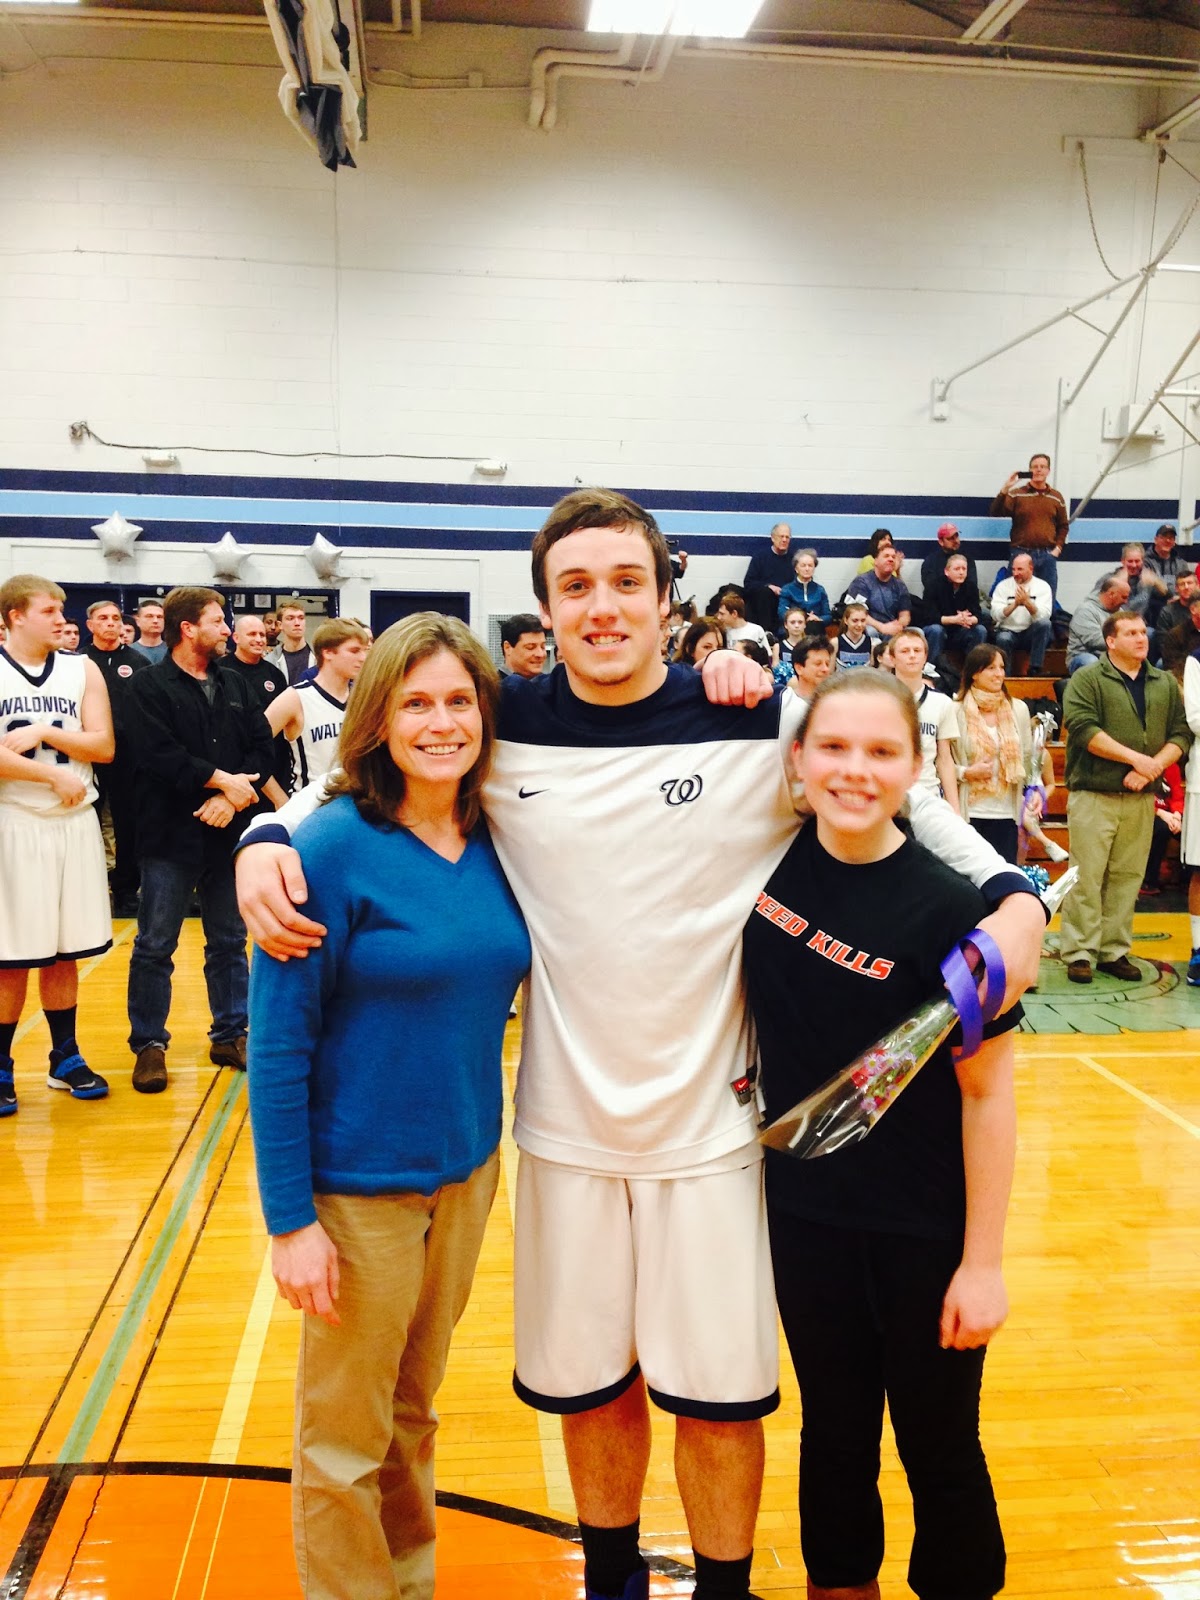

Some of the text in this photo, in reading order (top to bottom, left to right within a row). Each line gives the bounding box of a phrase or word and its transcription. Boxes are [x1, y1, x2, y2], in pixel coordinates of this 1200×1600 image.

[310, 722, 343, 743] WAL
[659, 774, 703, 807] W
[806, 929, 895, 980] KILLS
